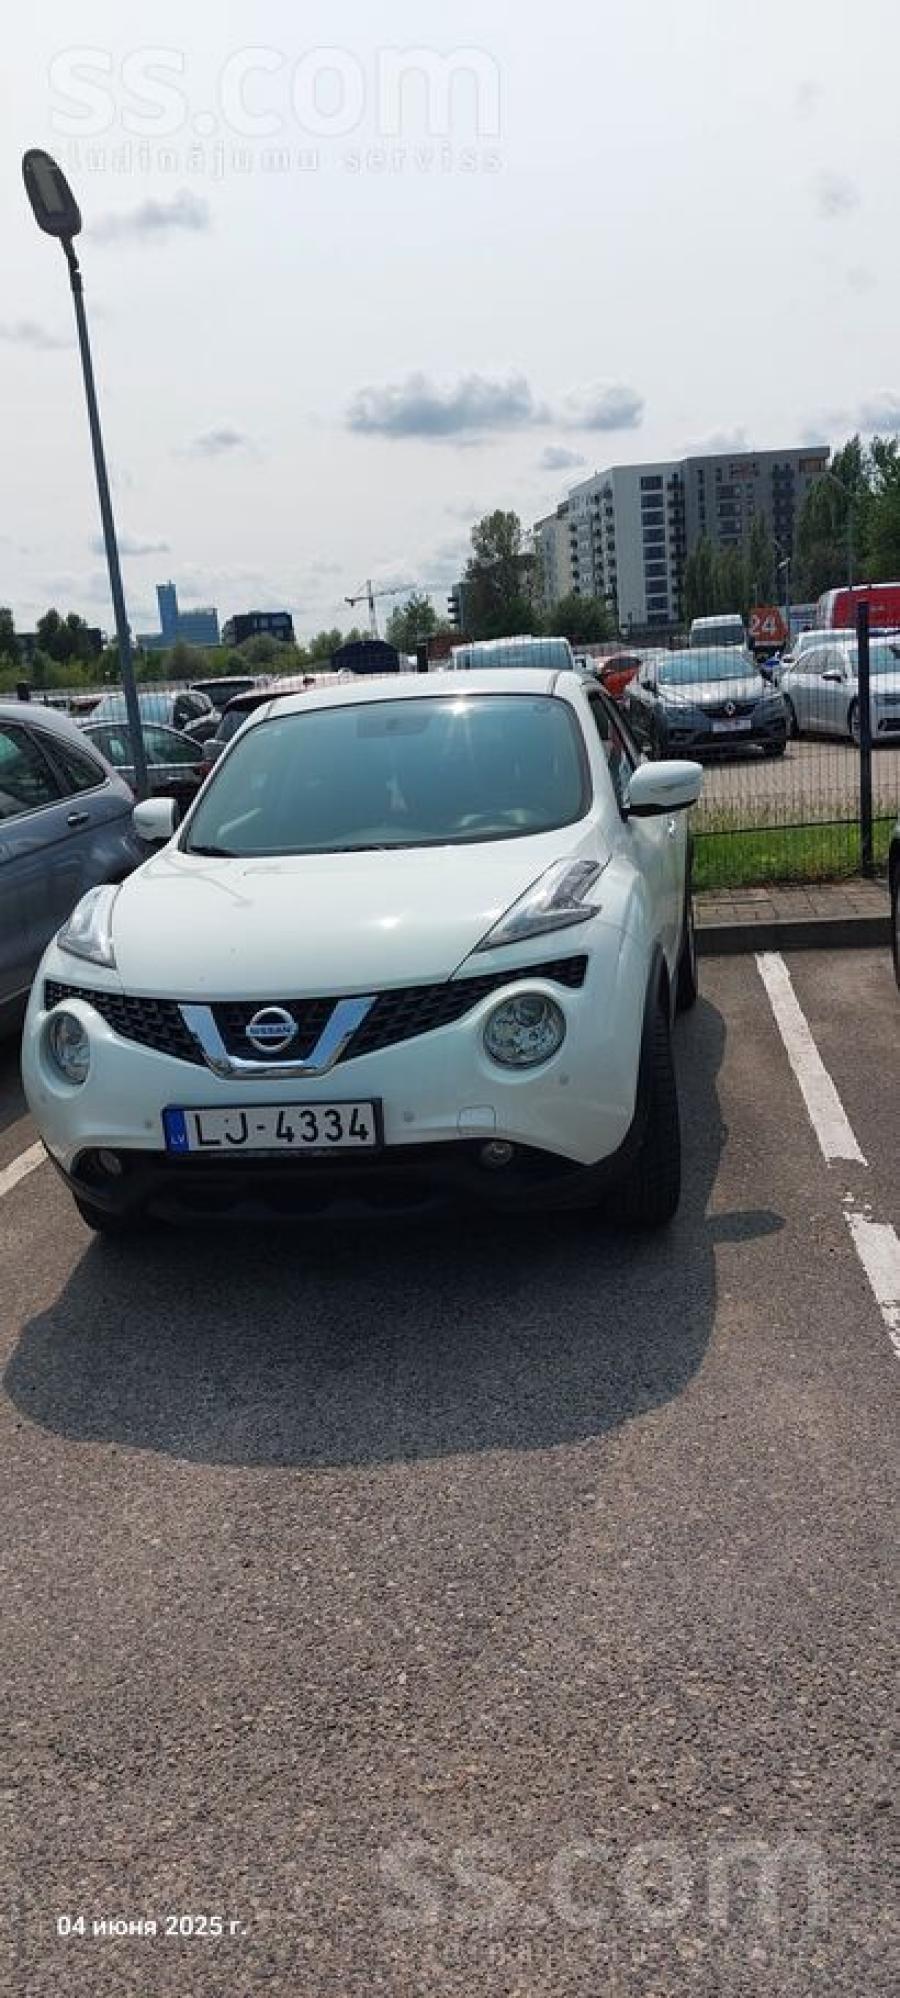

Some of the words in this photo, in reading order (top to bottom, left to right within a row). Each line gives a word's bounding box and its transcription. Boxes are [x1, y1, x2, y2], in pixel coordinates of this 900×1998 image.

[750, 614, 776, 635] 24
[249, 1024, 293, 1035] NISSAN
[194, 1108, 369, 1146] LJ-4334
[170, 1134, 185, 1145] LV
